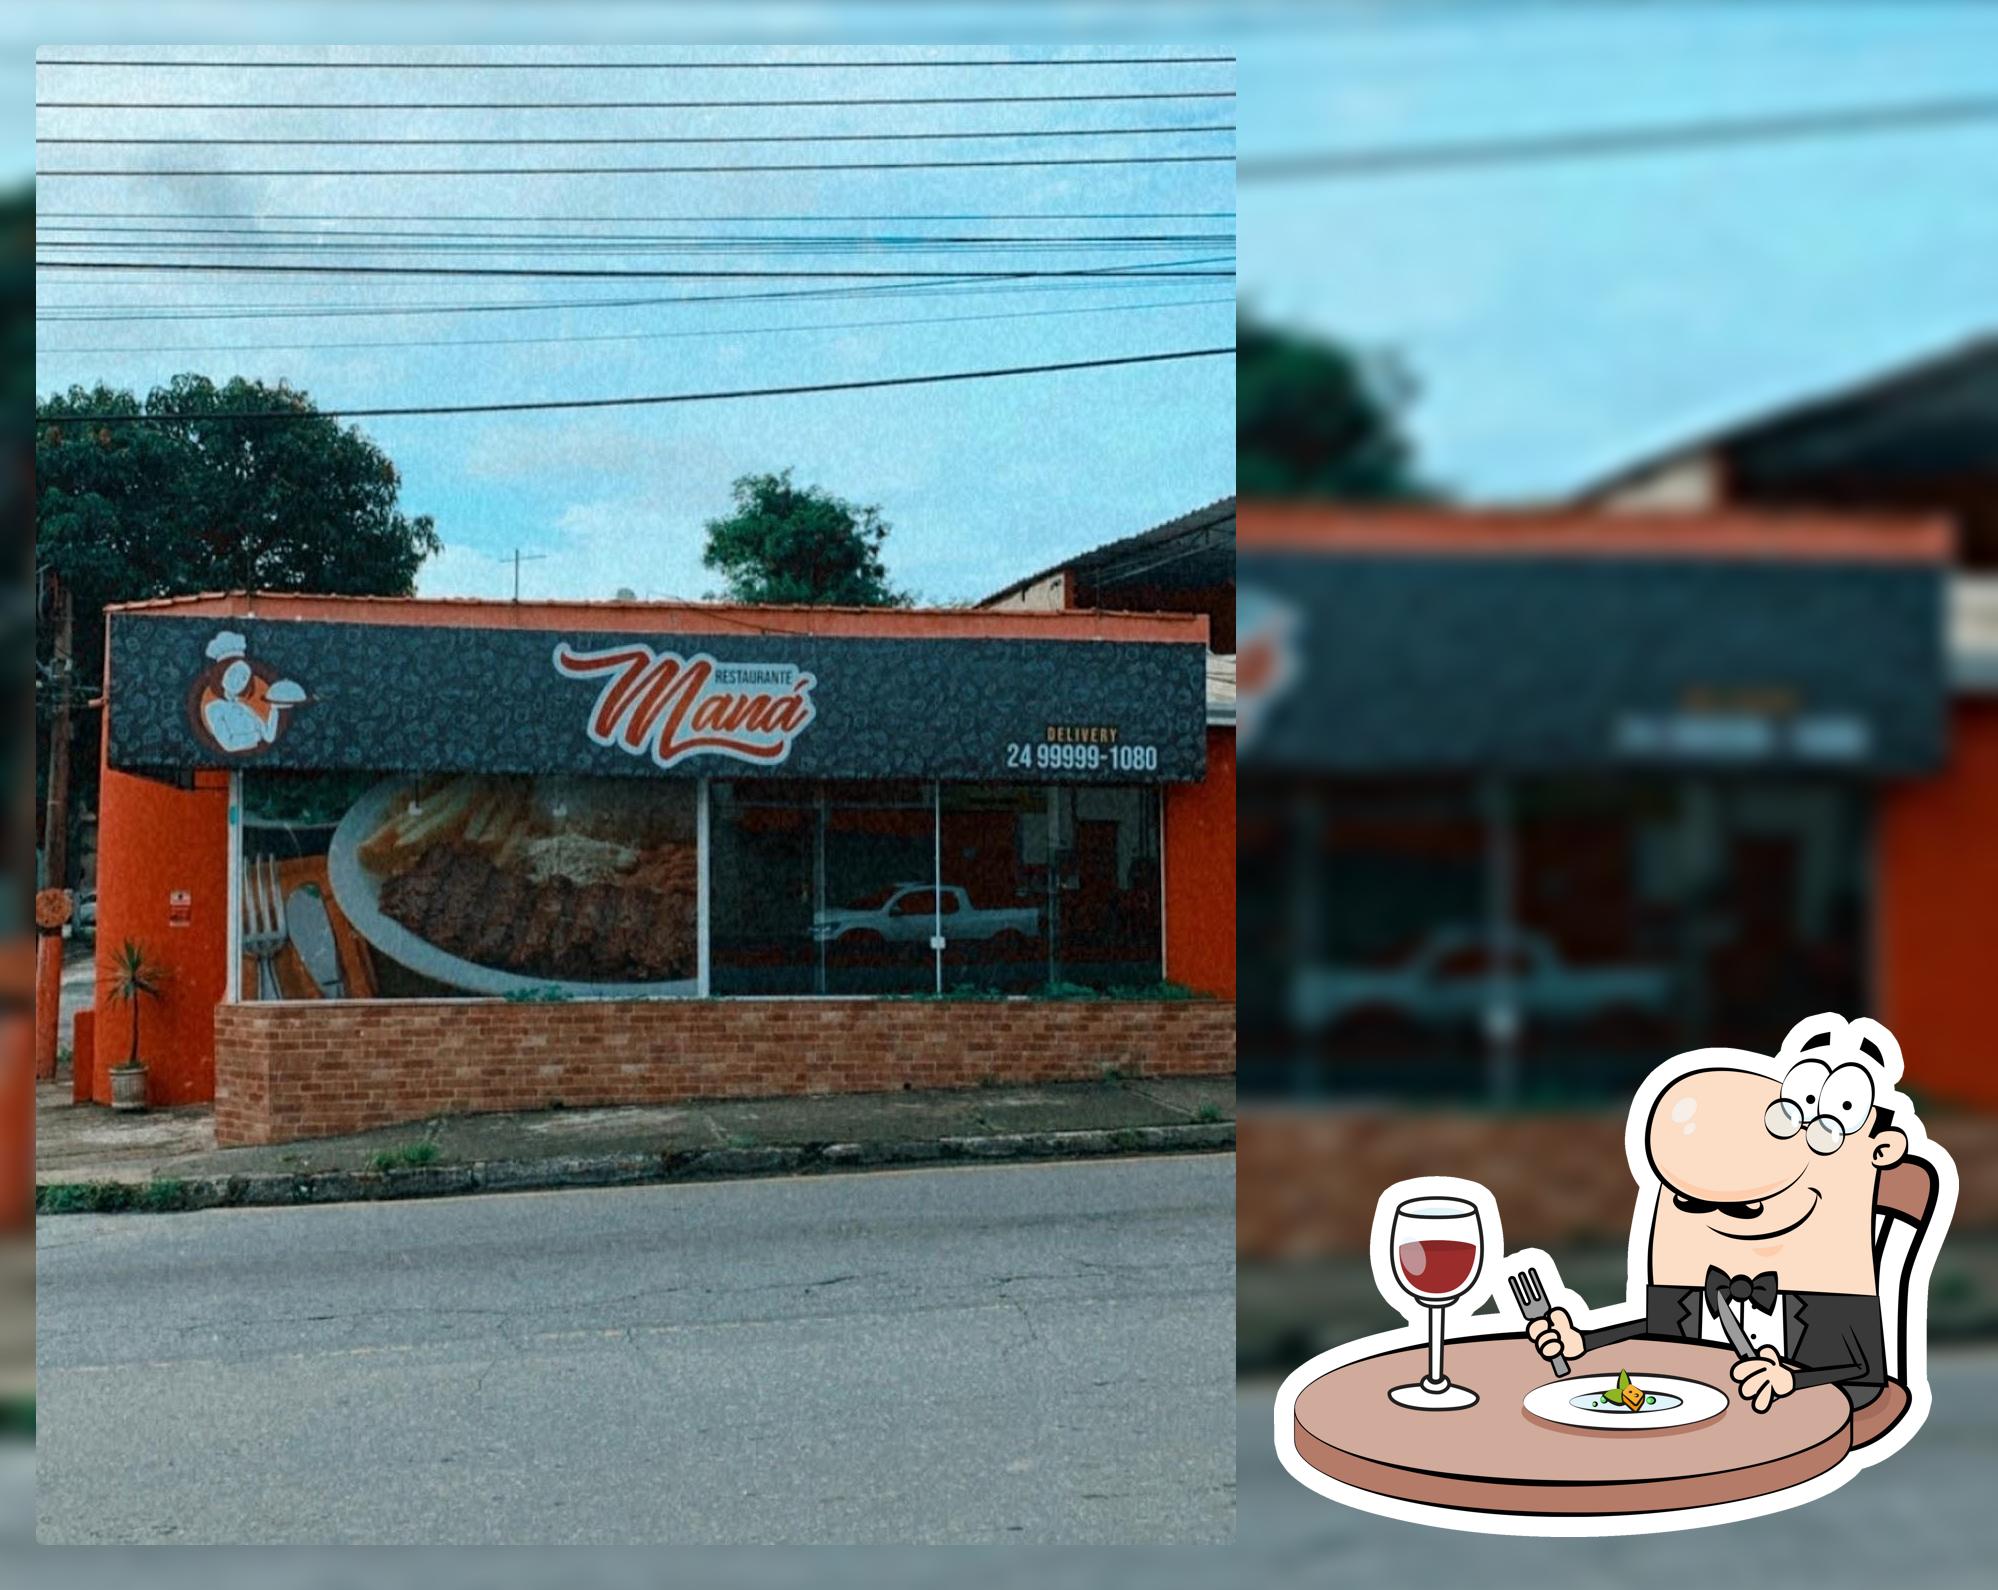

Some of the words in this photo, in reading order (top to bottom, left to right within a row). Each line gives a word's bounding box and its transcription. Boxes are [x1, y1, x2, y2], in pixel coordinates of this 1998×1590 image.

[714, 669, 793, 685] RESTAURANTE
[560, 651, 809, 761] Maná
[1047, 726, 1118, 743] DELIVERY
[1007, 743, 1033, 768] 24
[1036, 743, 1158, 770] 99999-1080
